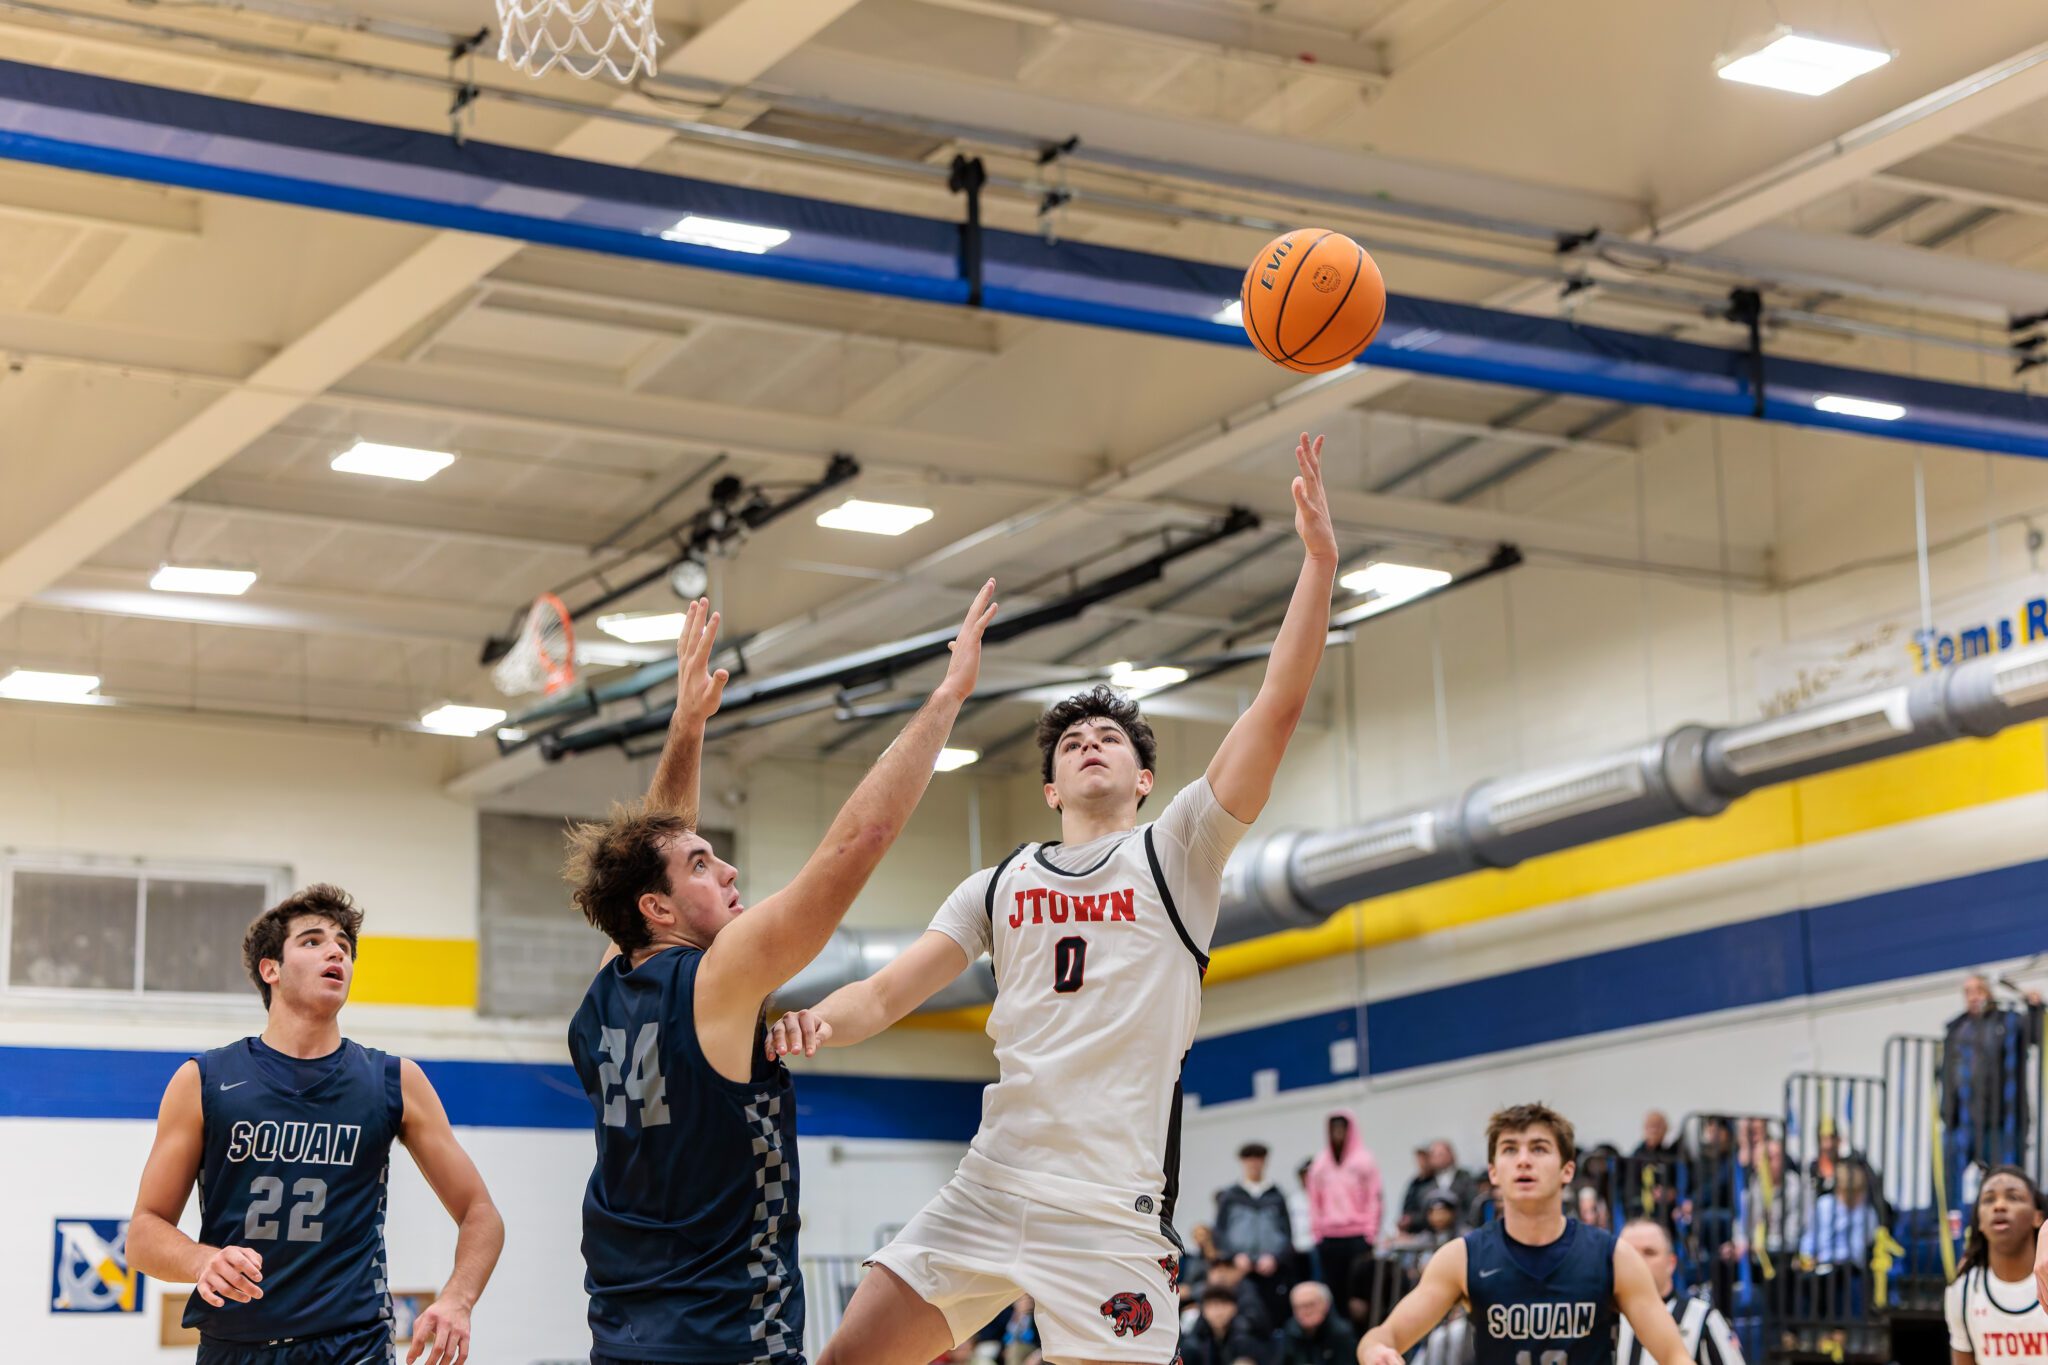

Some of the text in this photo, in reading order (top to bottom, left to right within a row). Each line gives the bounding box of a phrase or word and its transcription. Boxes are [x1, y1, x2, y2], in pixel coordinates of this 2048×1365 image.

[1906, 619, 2013, 675] Toms
[1008, 888, 1136, 929] JTOWN
[1053, 935, 1088, 994] 0
[598, 1022, 671, 1129] 24
[226, 1120, 362, 1166] SQUAN
[244, 1176, 328, 1242] 22
[1487, 1302, 1596, 1340] SQUAN
[1984, 1332, 2048, 1356] JTOW
